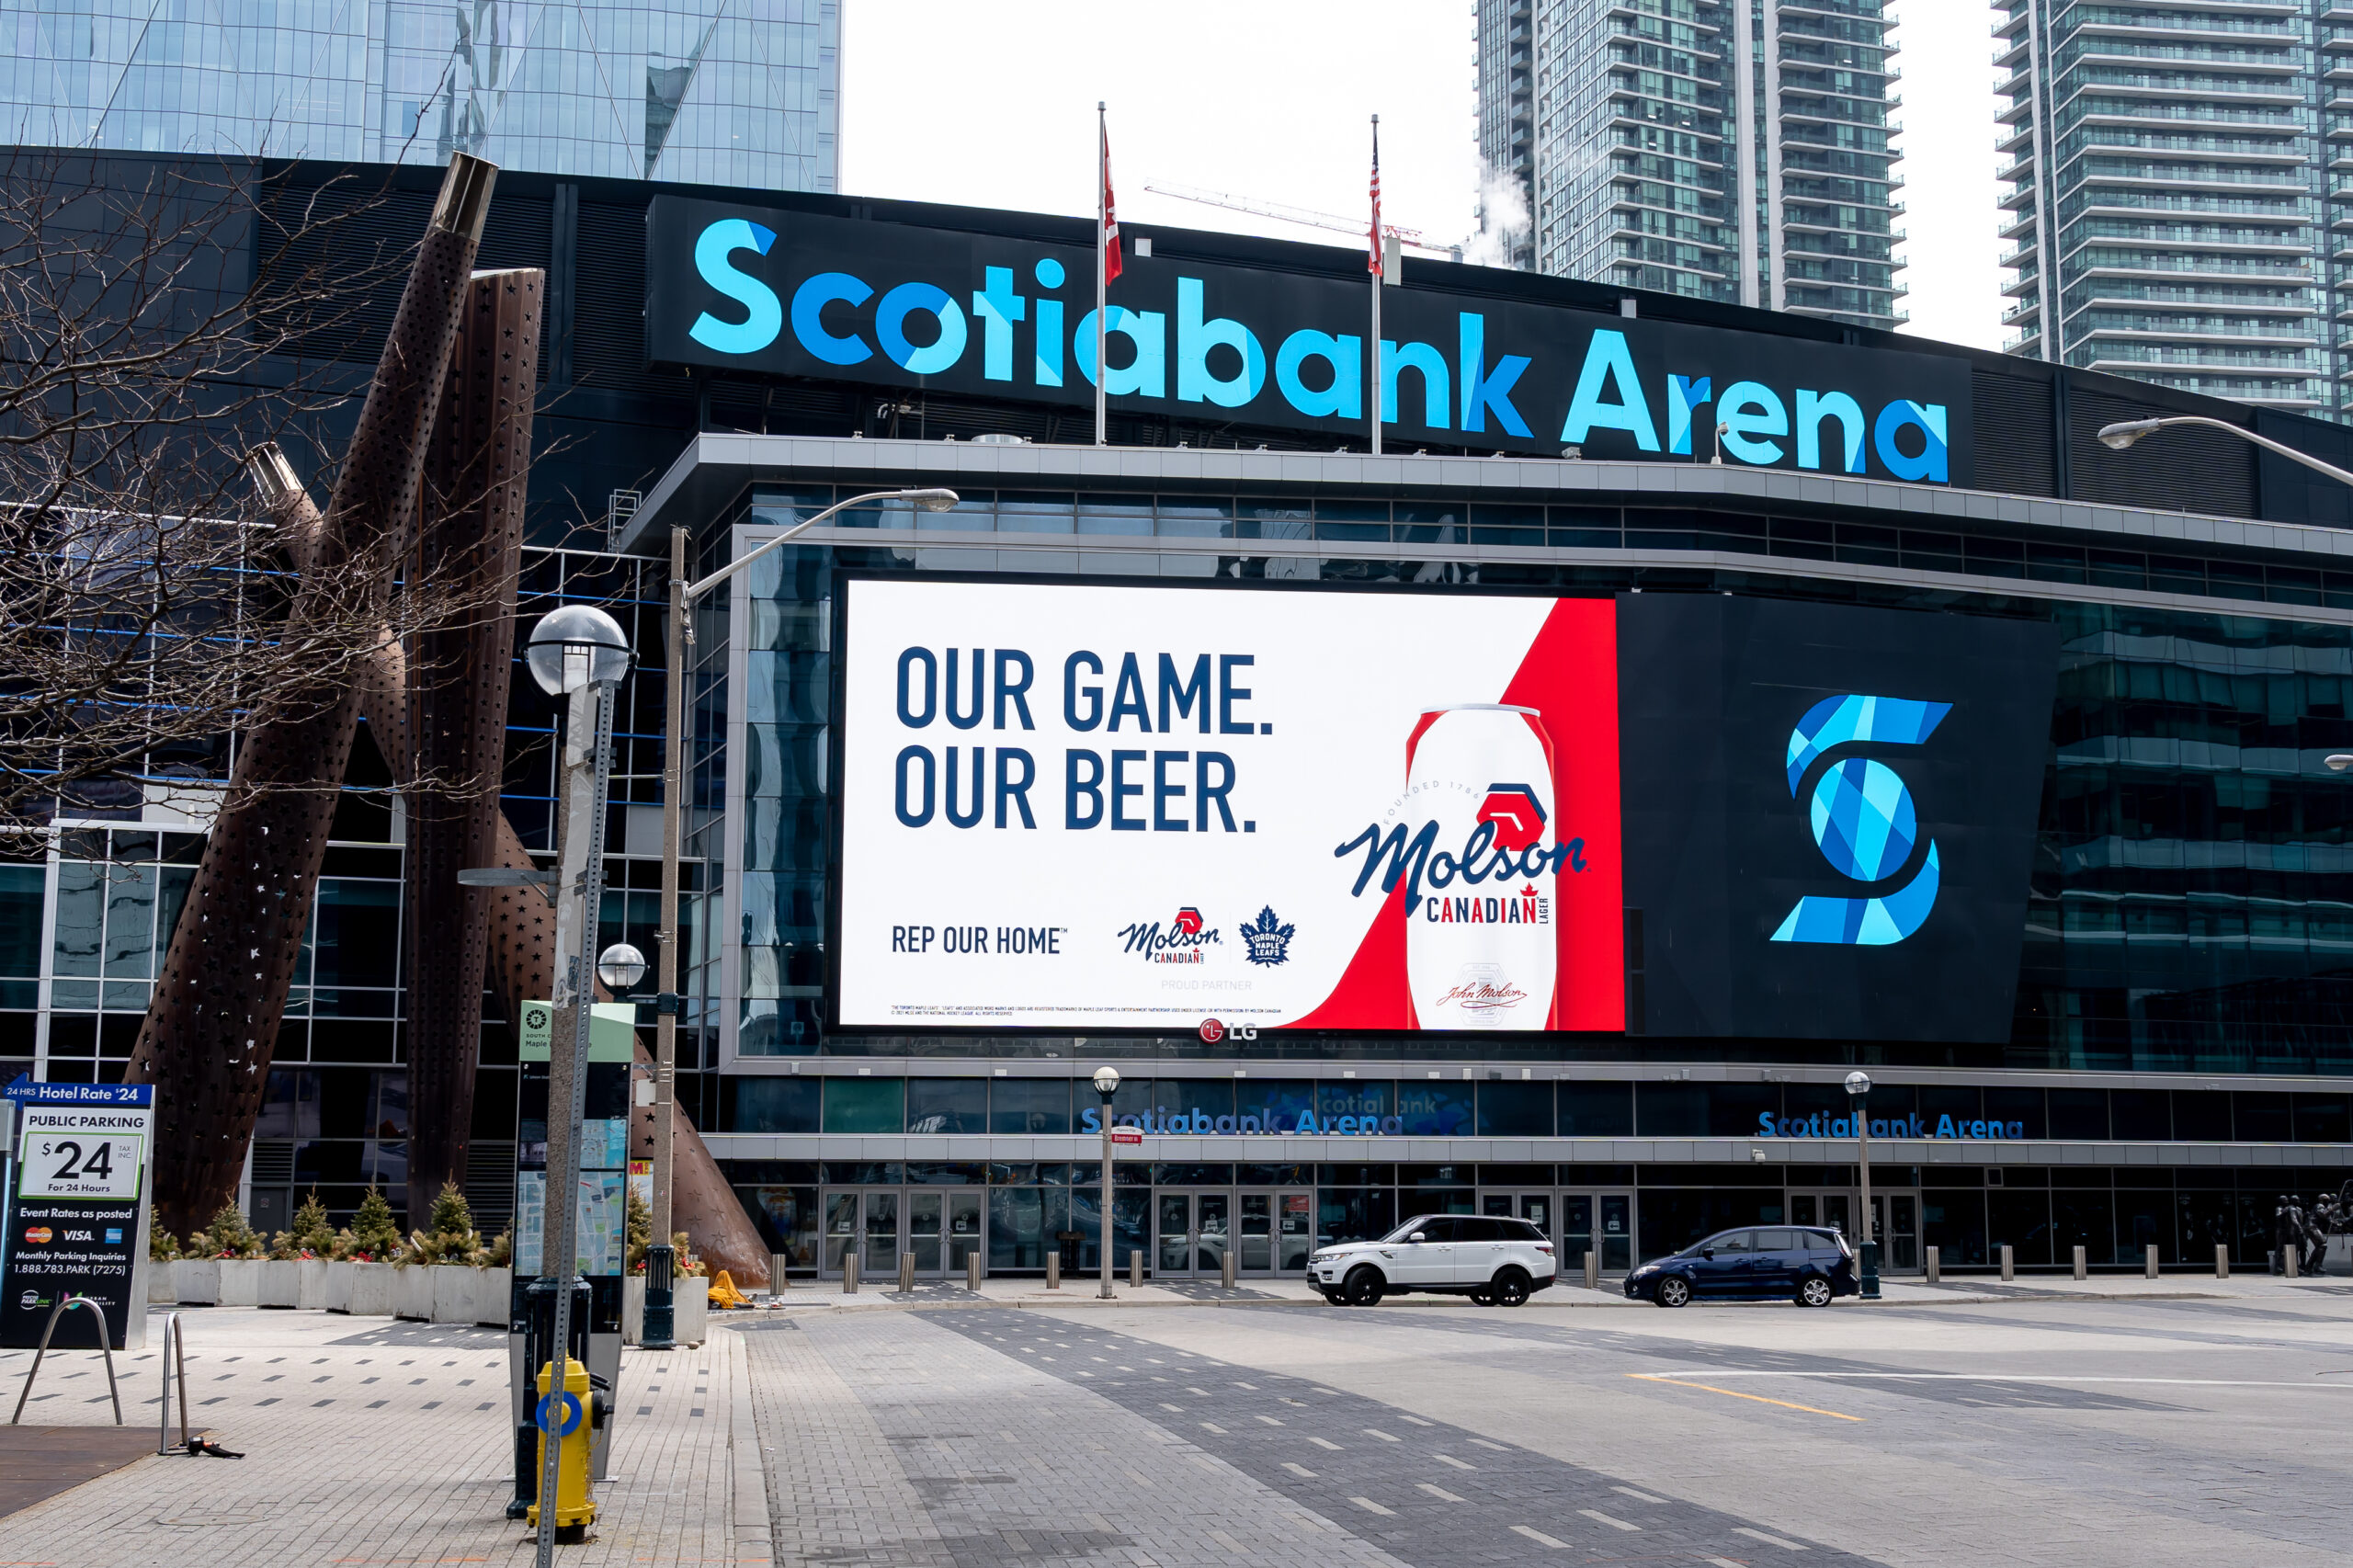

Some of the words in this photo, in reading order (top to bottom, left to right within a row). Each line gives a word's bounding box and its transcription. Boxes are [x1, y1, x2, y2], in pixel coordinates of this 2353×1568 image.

[688, 219, 1535, 438] Scotiabank
[1560, 328, 1949, 483] Arena
[896, 646, 1036, 730] OUR
[1063, 650, 1272, 735] GAME.
[895, 744, 1038, 829] OUR
[1065, 748, 1256, 833] BEER.
[1383, 780, 1439, 825] FOUNDED
[1450, 781, 1480, 799] 1786
[1334, 819, 1587, 918] Molson
[1427, 896, 1537, 924] CANADIAN
[1540, 898, 1549, 925] LAGER
[892, 926, 935, 953] REP
[943, 926, 988, 954] OUR
[1117, 921, 1220, 961] Molson
[1249, 933, 1286, 945] TORONTO
[1154, 953, 1199, 964] CANADIAN
[1161, 980, 1199, 990] PROUD
[1202, 980, 1252, 991] PARTNER
[1437, 982, 1476, 1006] John
[1476, 982, 1528, 999] Molson
[1229, 1022, 1257, 1040] LG
[39, 1086, 77, 1099] Hotel
[81, 1088, 112, 1100] Rate
[115, 1088, 138, 1101] $24
[28, 1116, 76, 1127] PUBLIC
[79, 1117, 144, 1128] PARKING
[1081, 1106, 1282, 1136] Sotiabank
[1293, 1109, 1403, 1136] Arena
[1935, 1114, 2023, 1140] Arena
[66, 1184, 79, 1192] 24
[81, 1185, 110, 1193] Hours
[20, 1208, 49, 1218] Event
[51, 1209, 79, 1219] Rates
[81, 1210, 94, 1219] as
[96, 1209, 132, 1221] posted
[63, 1230, 92, 1241] VISA
[16, 1251, 51, 1261] Monthly
[54, 1252, 87, 1262] Parking
[89, 1253, 126, 1262] Inquiries
[15, 1264, 90, 1274] 1.888.783.PARK
[93, 1265, 126, 1276] (7275)
